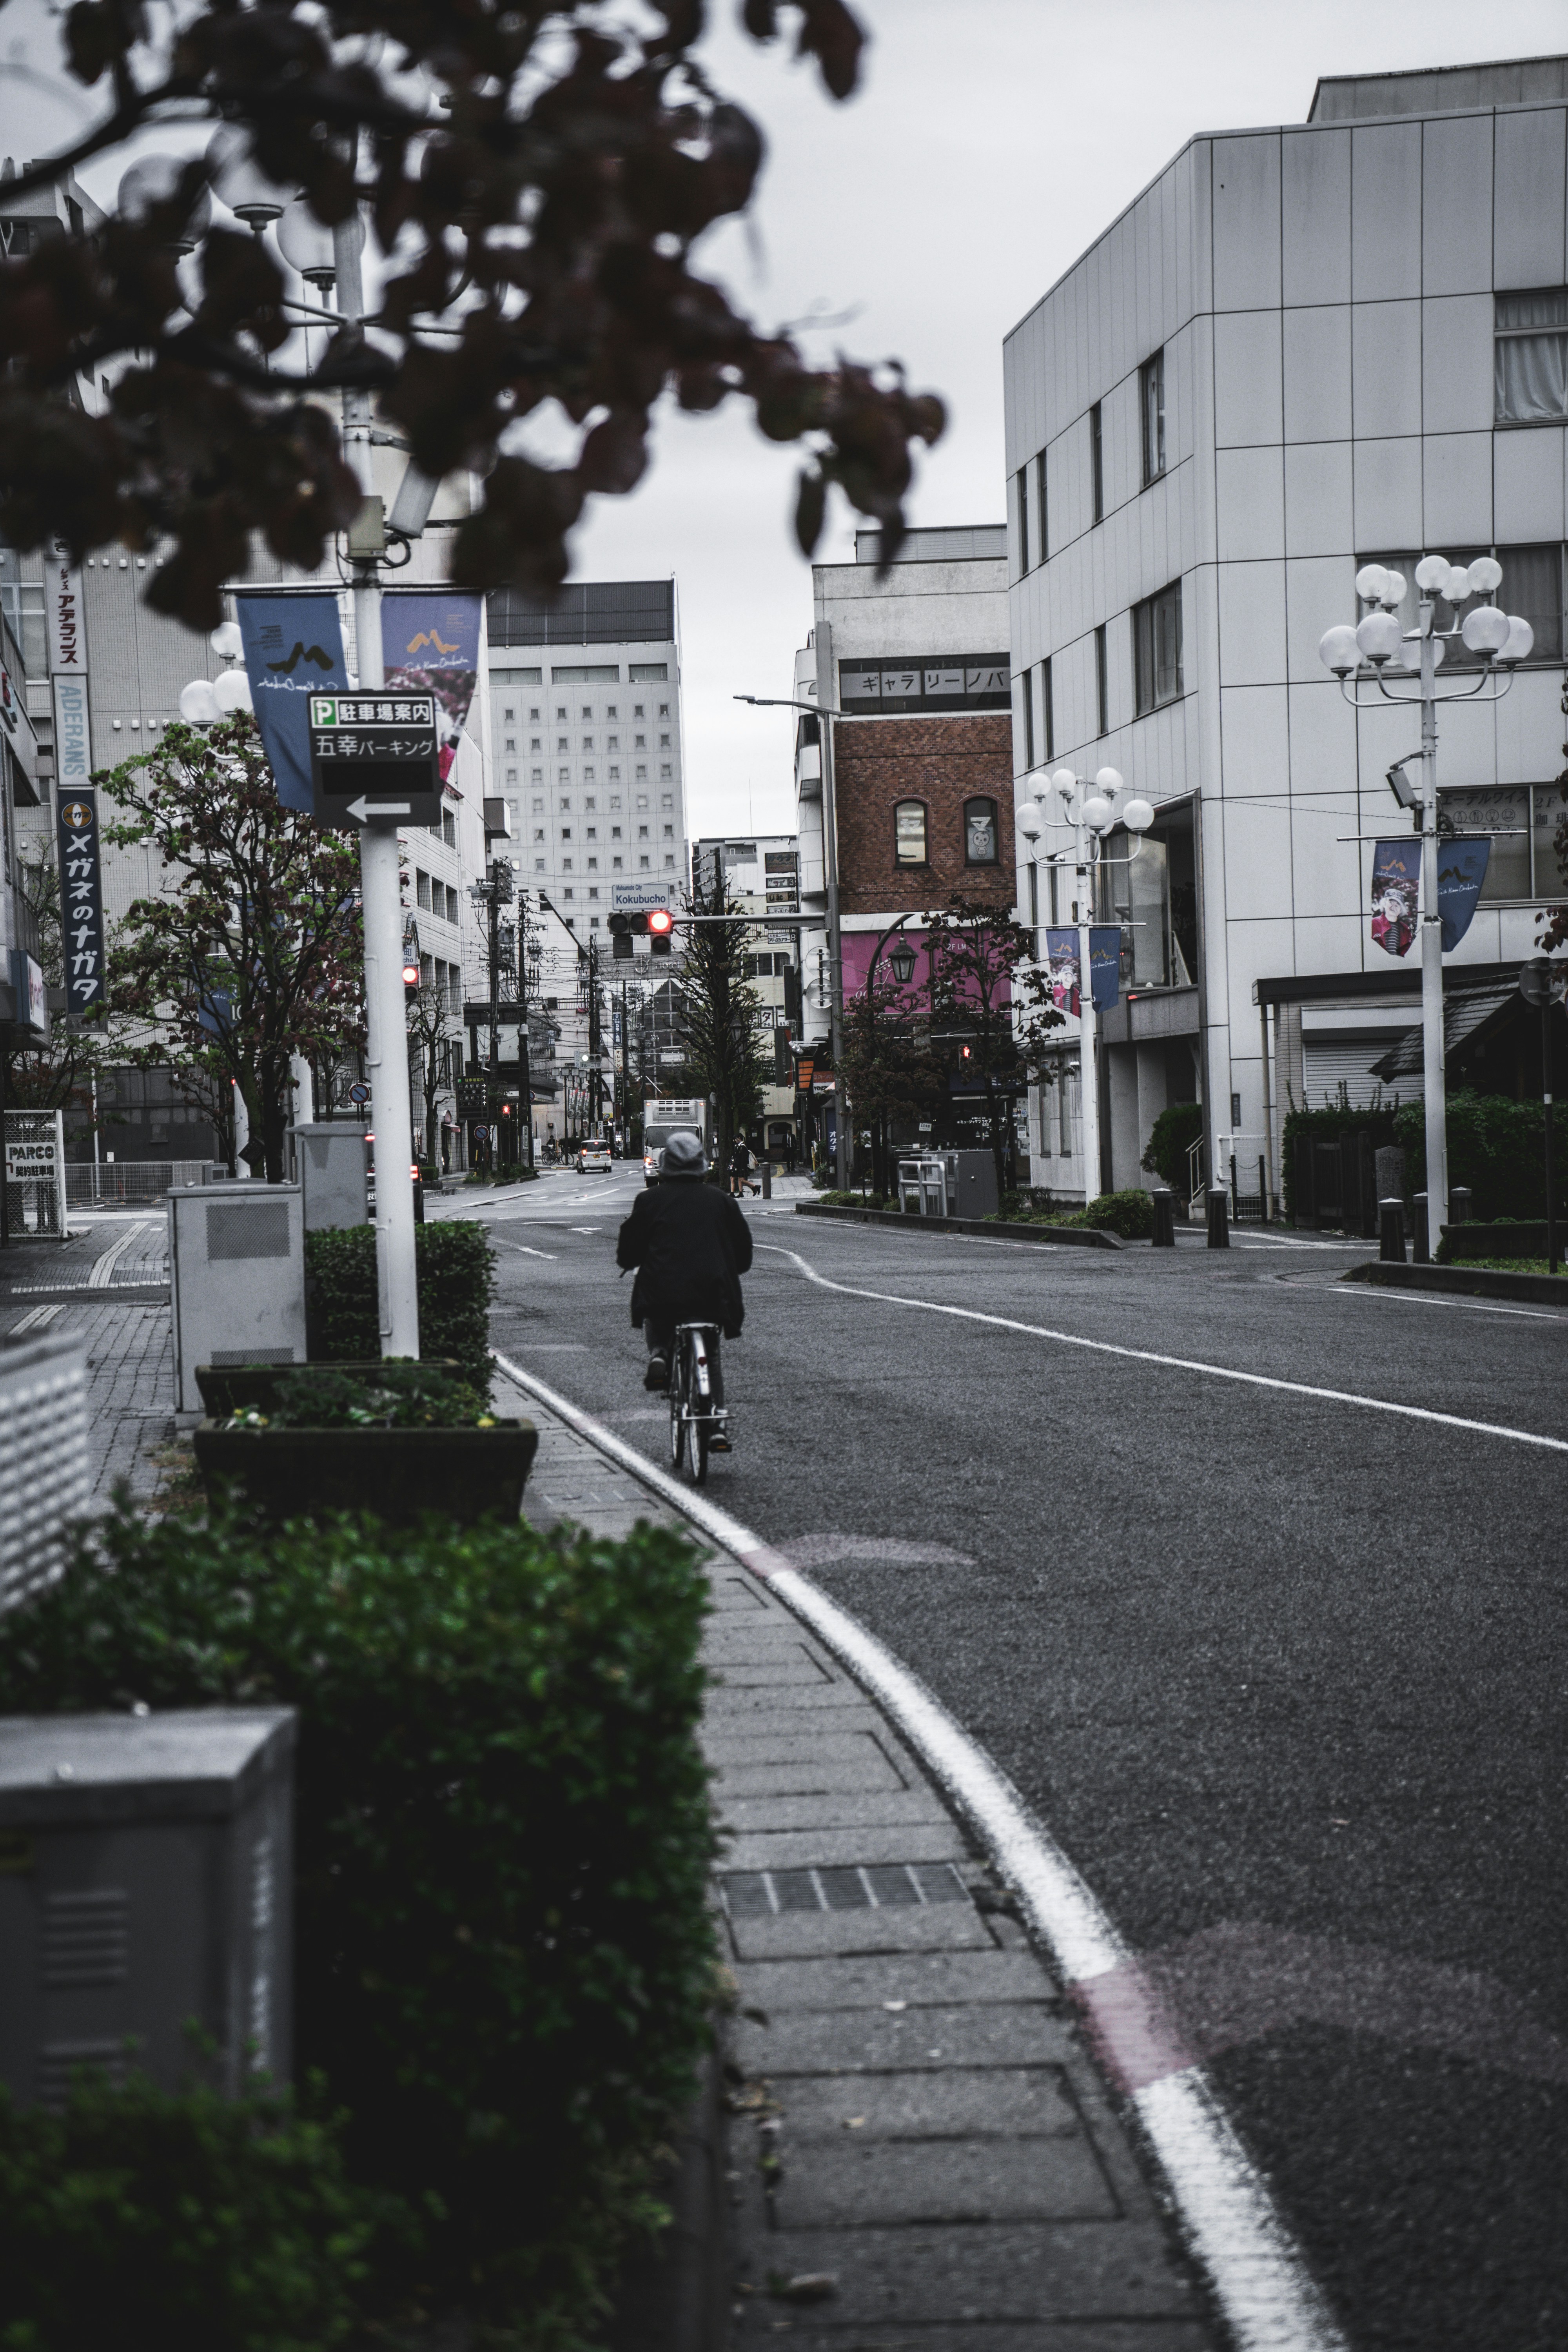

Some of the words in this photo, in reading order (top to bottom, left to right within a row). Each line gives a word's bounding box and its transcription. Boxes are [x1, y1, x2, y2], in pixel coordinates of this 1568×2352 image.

[60, 568, 69, 590] レディス
[58, 595, 78, 664] アデランス
[862, 671, 1005, 692] ギャラリーノバ
[339, 704, 430, 722] 駐車場案内
[58, 684, 86, 777] ADERANS
[316, 735, 433, 757] 五幸パーキング
[1441, 790, 1530, 806] エーデルワイス
[616, 894, 666, 904] Kokubucho
[65, 834, 99, 1000] メガネのナガタ
[9, 1146, 54, 1160] PARCO
[16, 1165, 54, 1178] 契約駐車場
